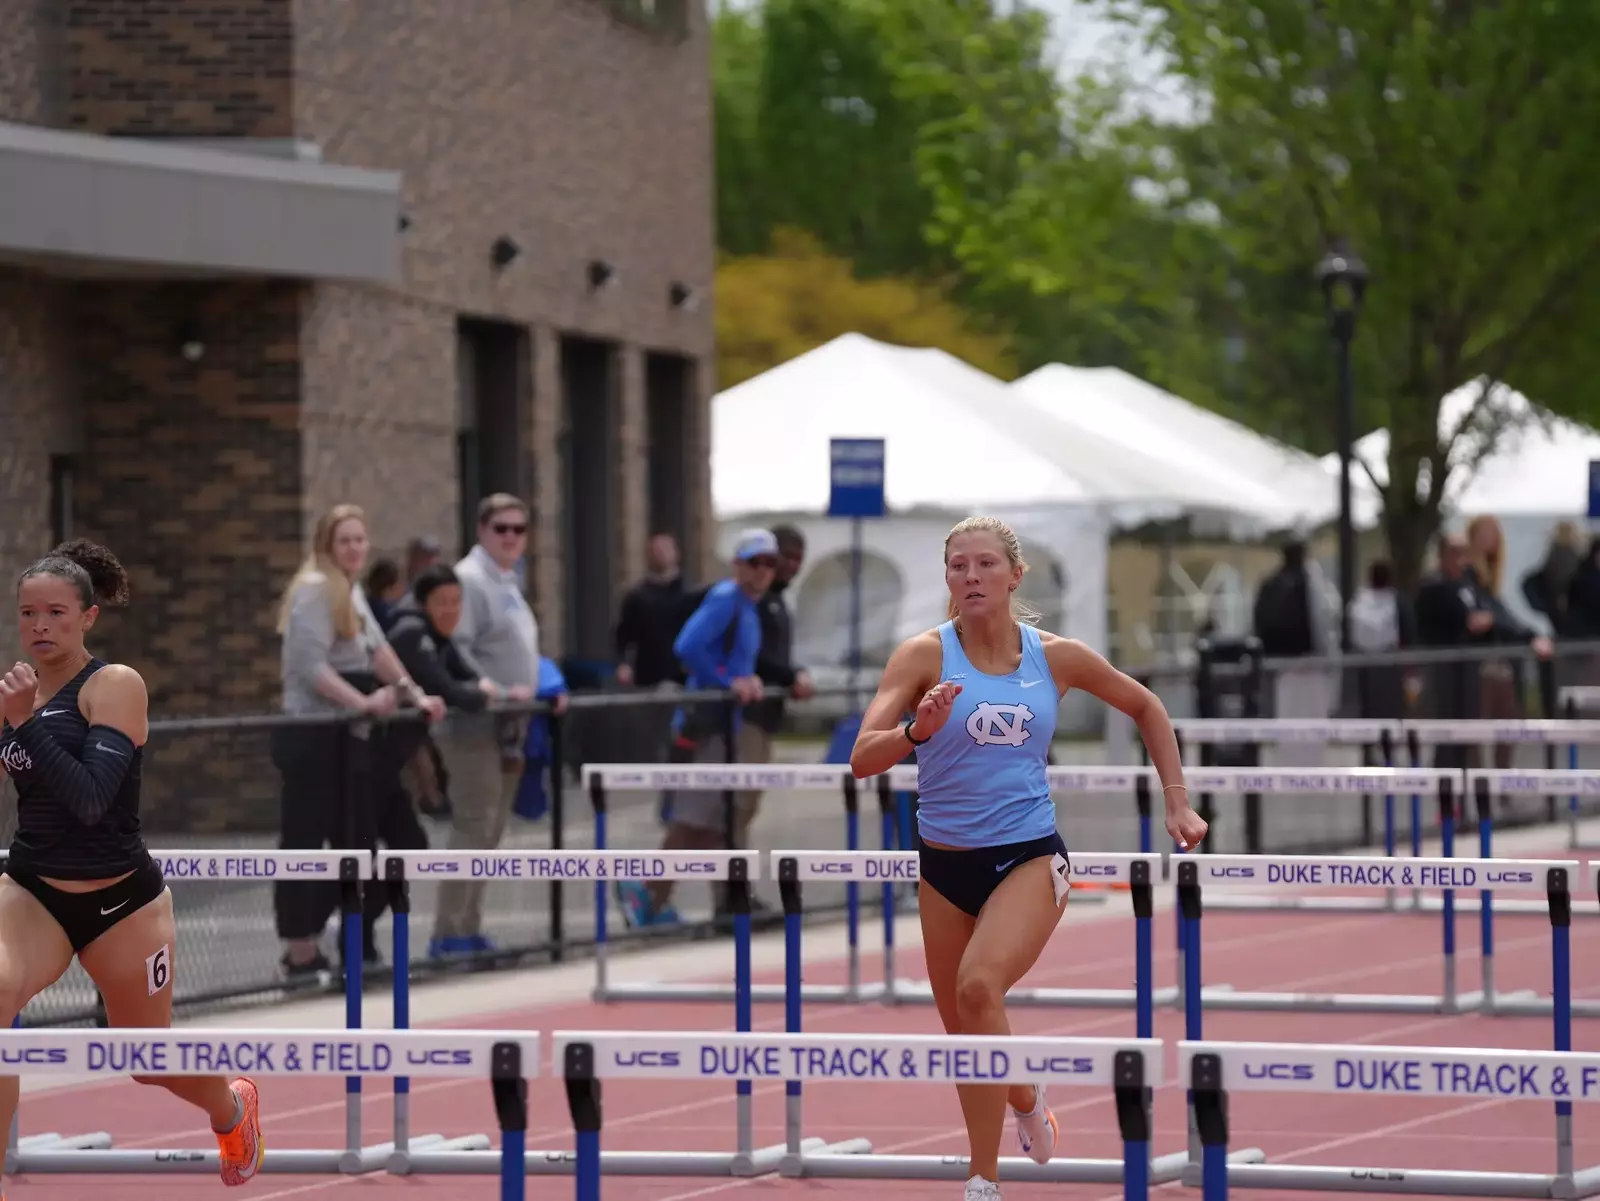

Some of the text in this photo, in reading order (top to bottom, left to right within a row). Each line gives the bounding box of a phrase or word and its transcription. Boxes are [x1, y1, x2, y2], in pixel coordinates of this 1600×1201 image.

[154, 858, 328, 877] ACK & FIELD UCS
[417, 858, 717, 877] UCS DUKE TRACK & FIELD UCS
[810, 859, 917, 878] UCS DUKE
[1073, 865, 1118, 876] UCS
[1210, 864, 1533, 886] UCS DUKE TRACK & FIELD UCS
[153, 949, 167, 988] 6
[1, 1042, 472, 1071] UCS DUKE TRACK & FIELD UCS
[615, 1046, 1093, 1079] UCS DUKE TRACK & FIELD UCS
[1244, 1064, 1314, 1080] UCS
[1335, 1060, 1421, 1091] DUKE
[1431, 1062, 1539, 1095] TRACK
[1550, 1066, 1570, 1096] &
